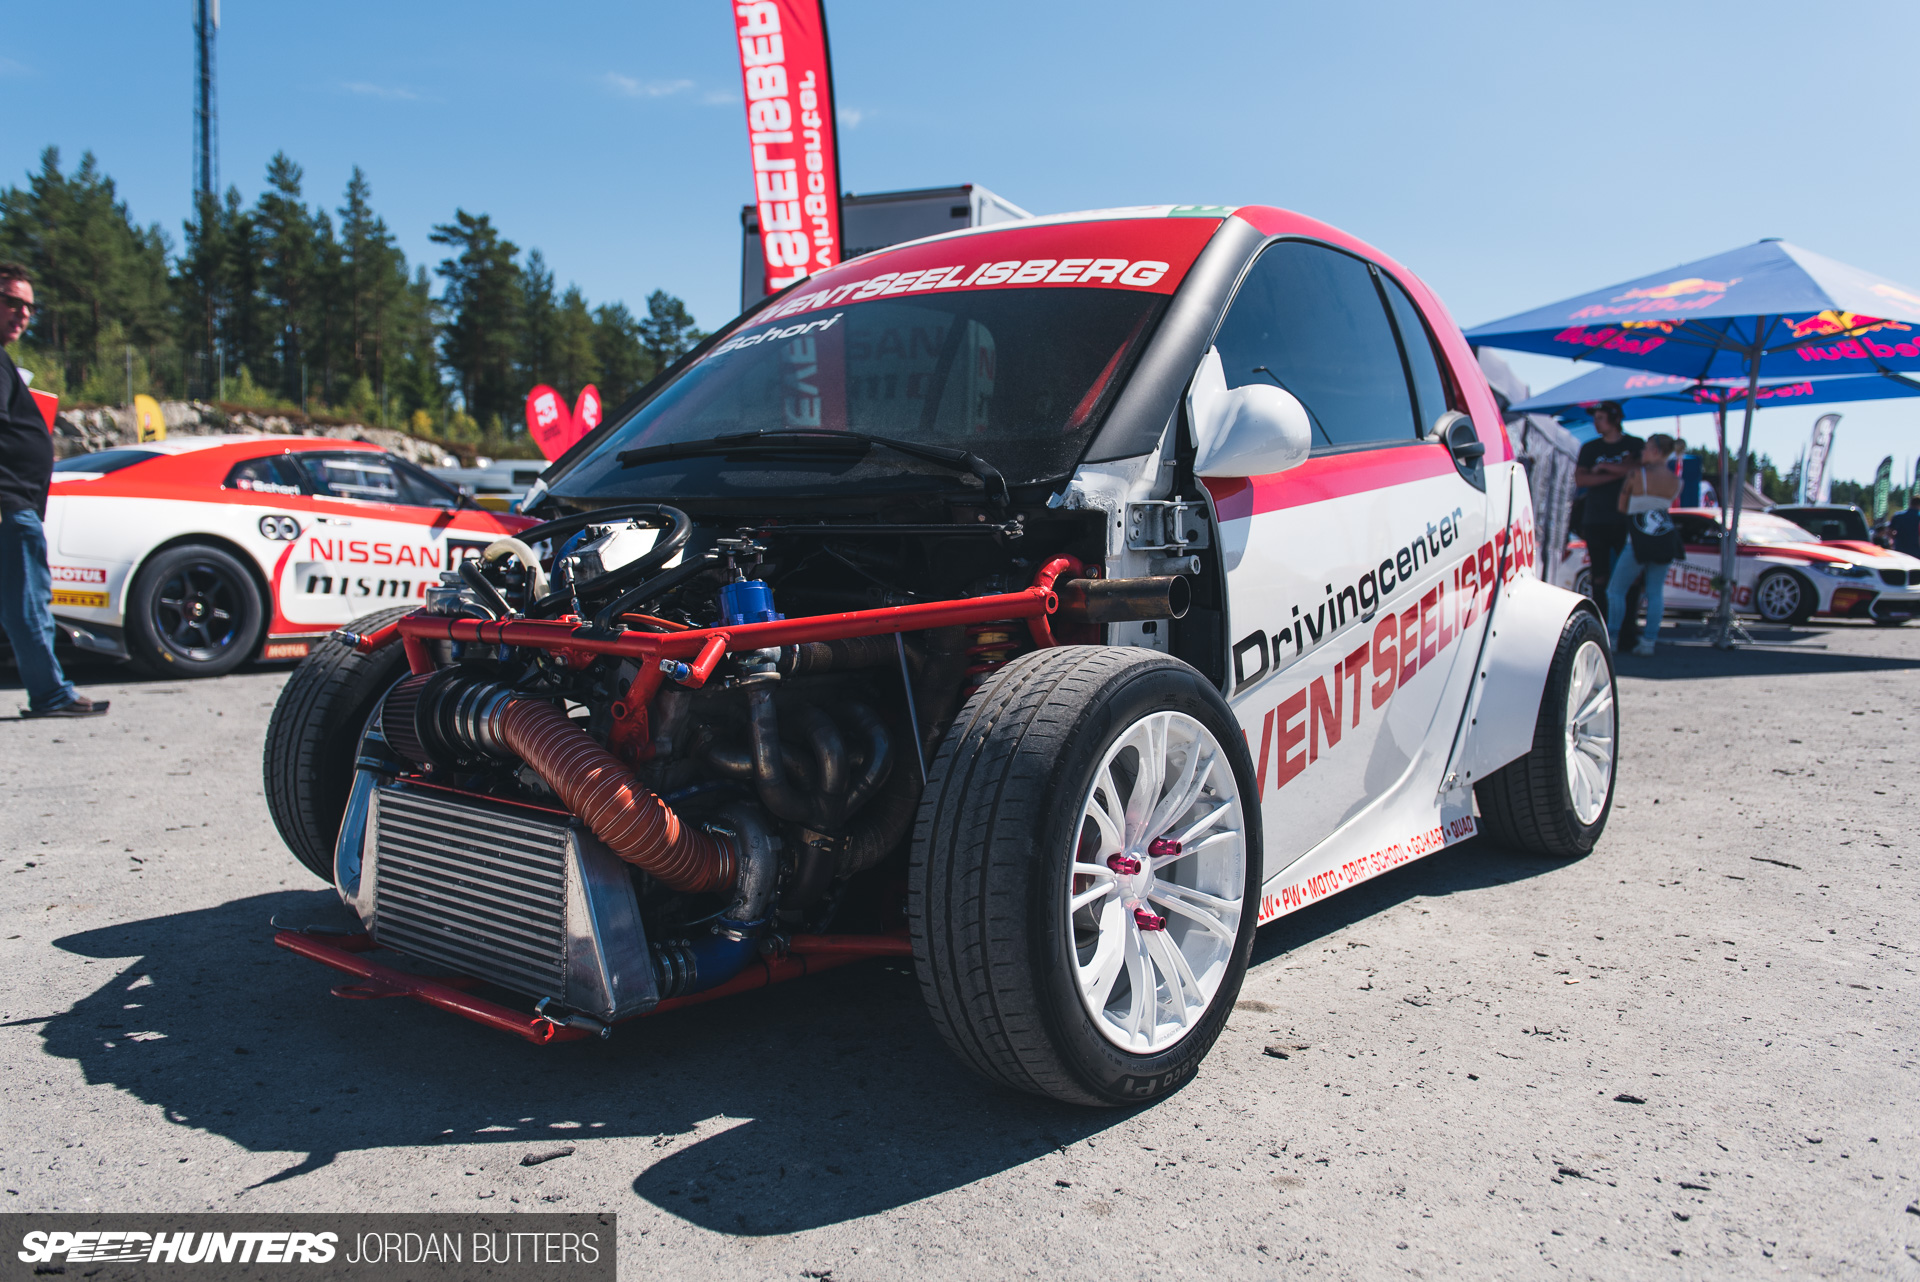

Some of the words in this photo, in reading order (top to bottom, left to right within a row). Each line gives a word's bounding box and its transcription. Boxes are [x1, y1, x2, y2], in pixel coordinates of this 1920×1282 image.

[709, 313, 844, 358] Schori
[51, 568, 104, 582] MOTUL
[310, 537, 441, 569] NISSAN
[1232, 506, 1463, 697] Drivingcenter
[1242, 505, 1535, 803] VENTSEELISBERG
[1282, 884, 1302, 910] PW
[1307, 870, 1339, 900] MOTO
[1450, 815, 1474, 838] QUAD
